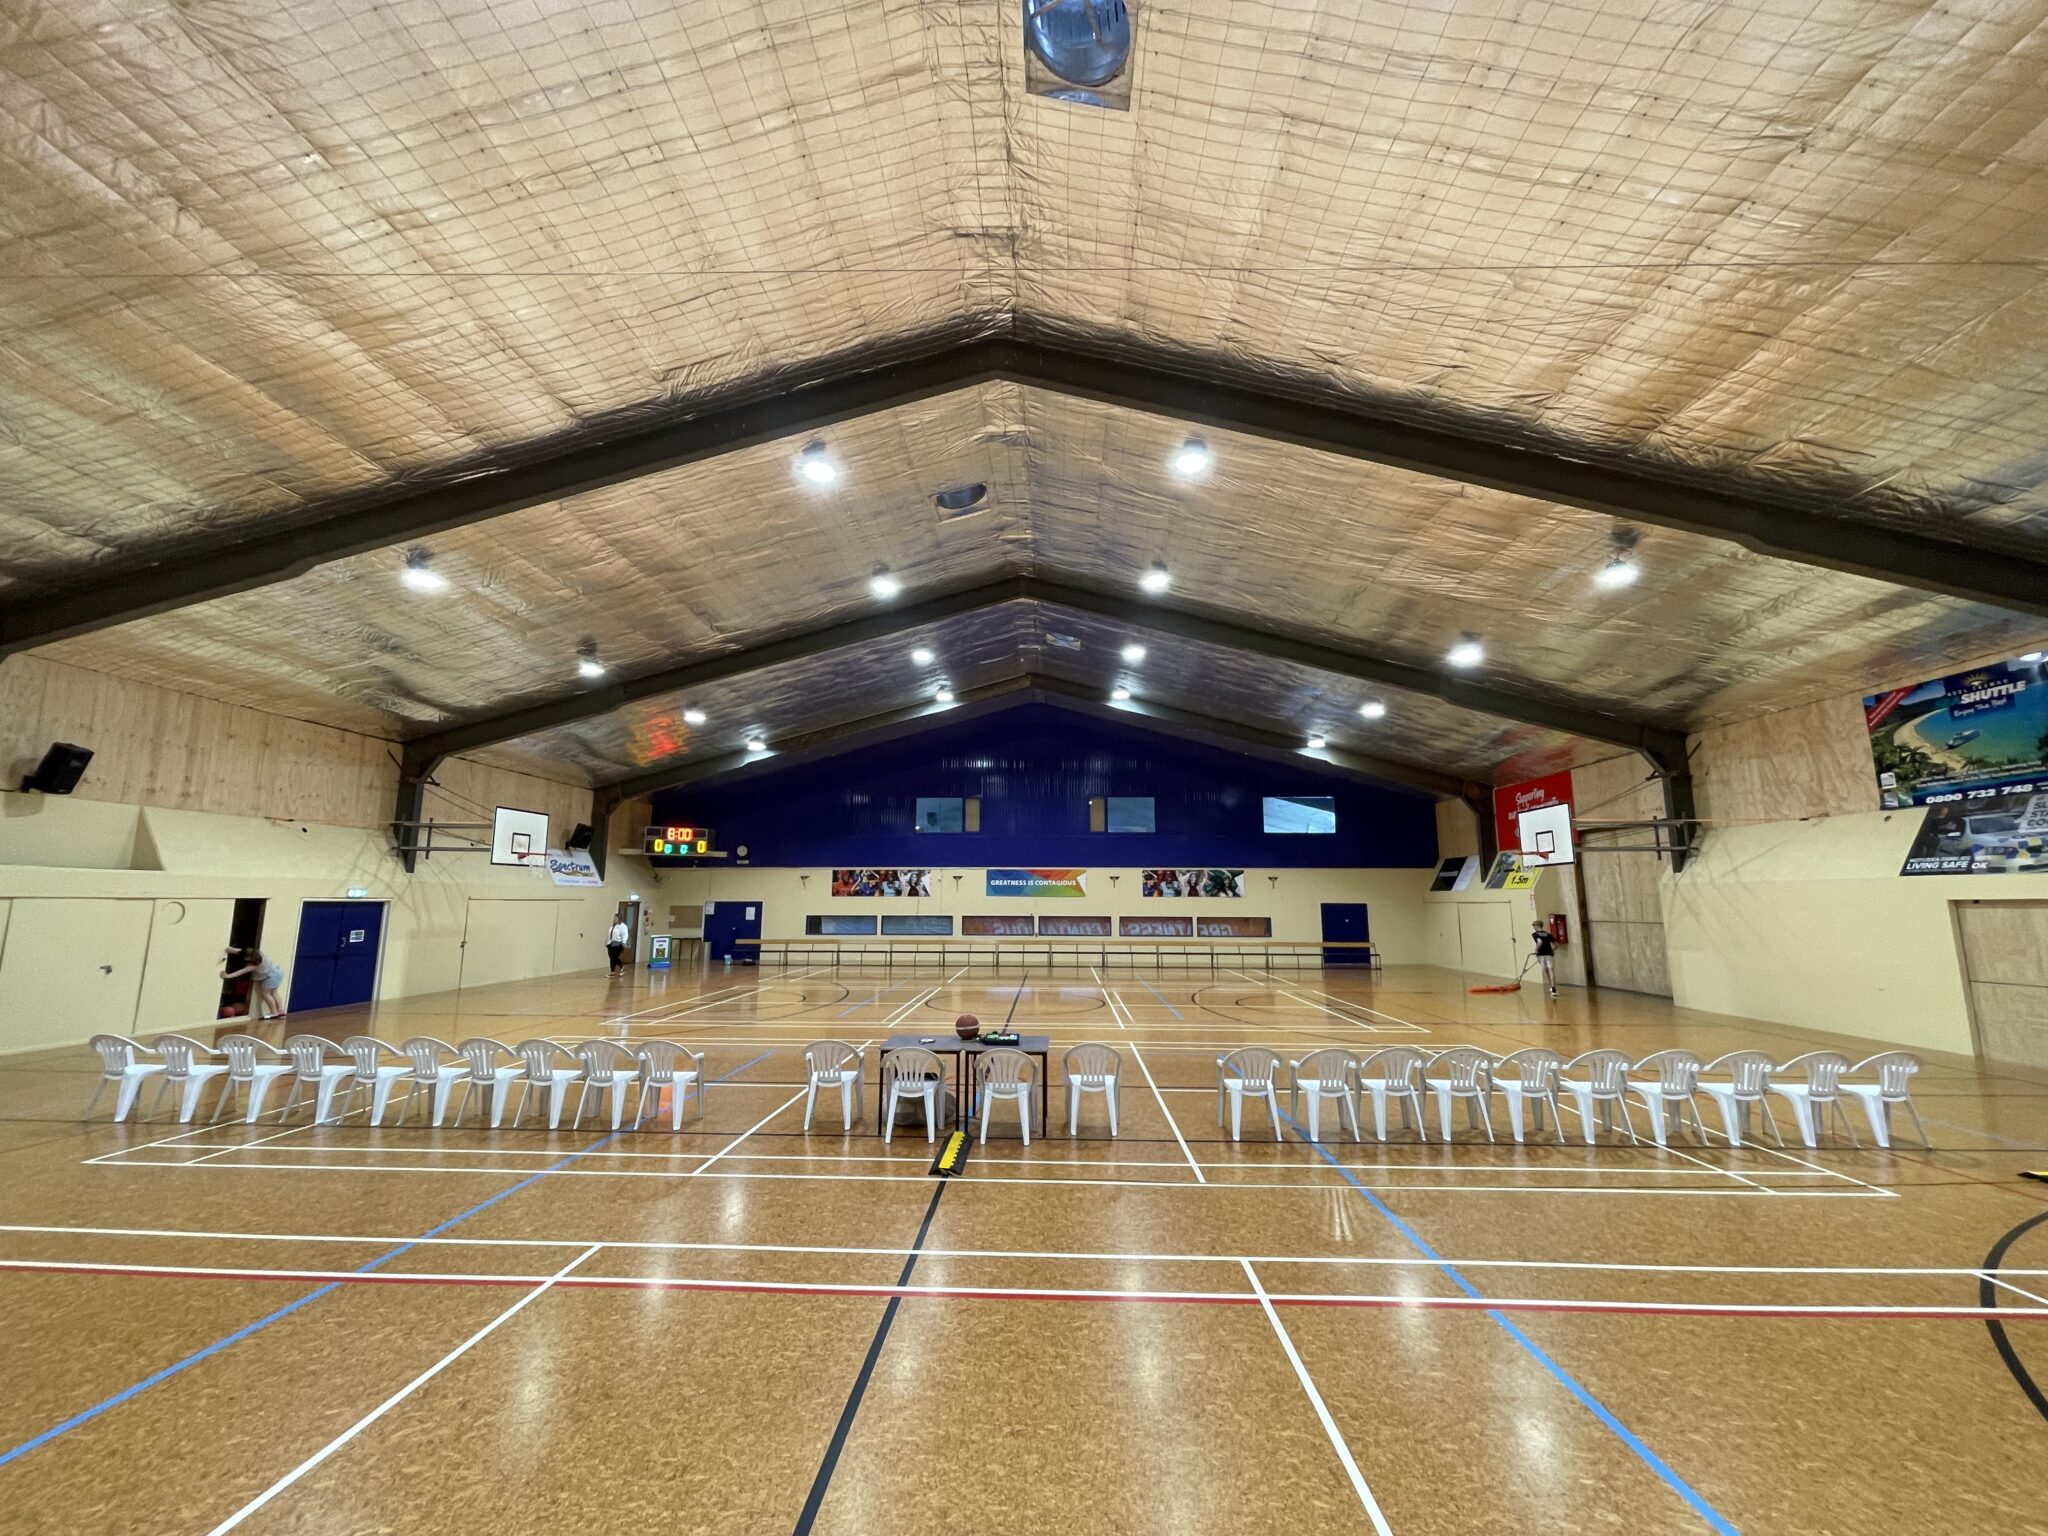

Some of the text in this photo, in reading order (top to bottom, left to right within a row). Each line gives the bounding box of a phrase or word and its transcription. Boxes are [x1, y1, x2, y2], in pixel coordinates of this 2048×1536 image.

[1961, 680, 2026, 704] SHUTTLE
[1926, 793, 1963, 804] 0800
[1967, 789, 1996, 799] 732
[667, 827, 692, 841] 8:00
[654, 838, 664, 852] 0
[697, 840, 706, 853] 0
[550, 860, 590, 873] Spectrum
[1906, 862, 1939, 870] LIVING
[1511, 875, 1529, 885] 1.5m
